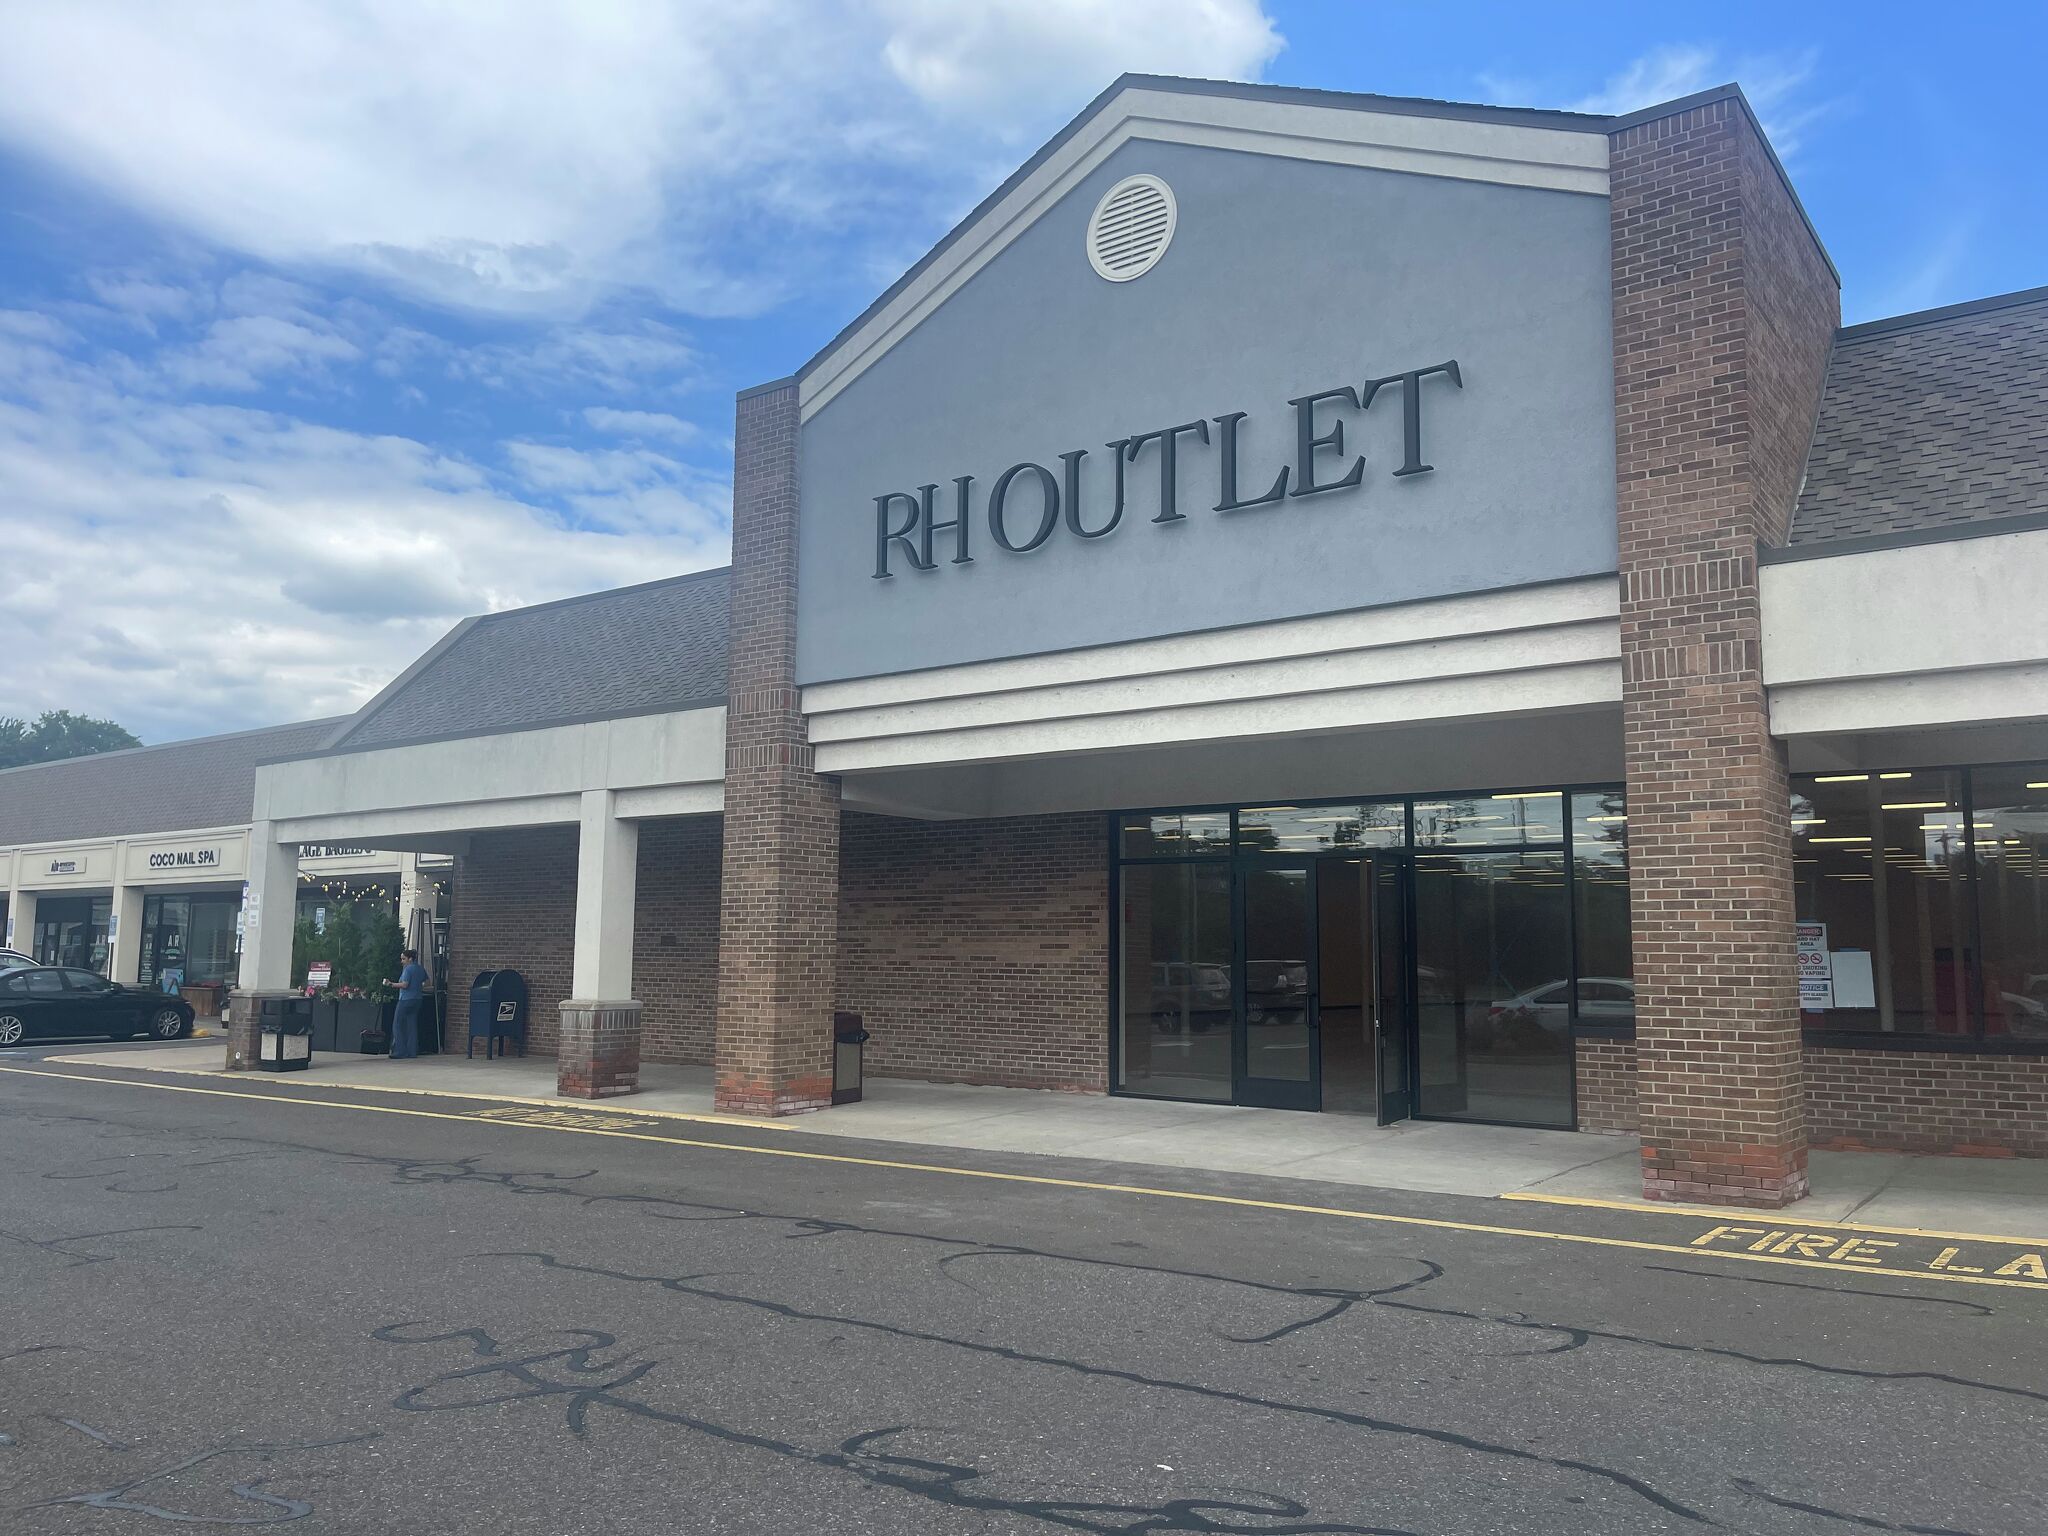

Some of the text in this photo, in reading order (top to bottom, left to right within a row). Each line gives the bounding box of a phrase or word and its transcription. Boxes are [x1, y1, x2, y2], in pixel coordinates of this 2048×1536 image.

[871, 360, 1464, 580] RH OUTLET
[150, 850, 215, 867] COCO NAIL SPA
[1690, 1226, 1899, 1263] FIRE
